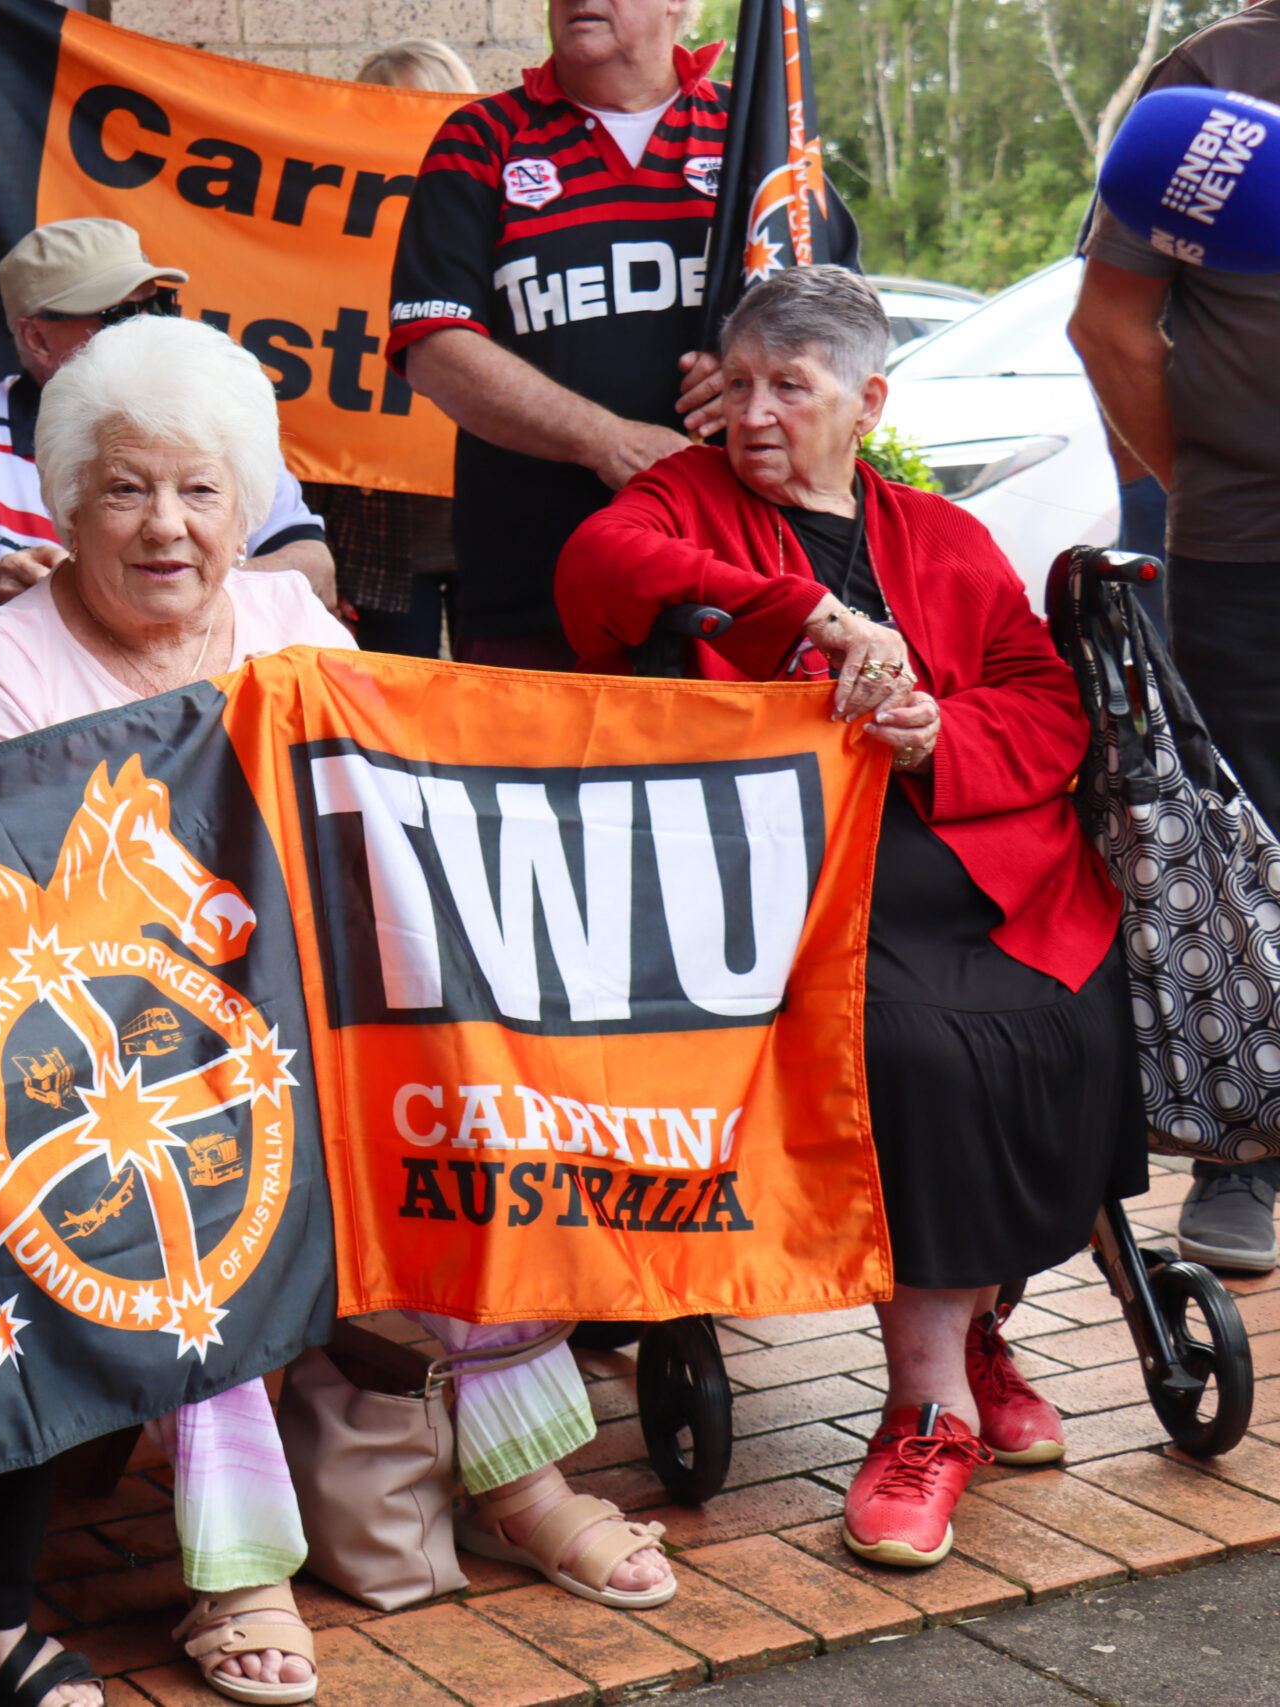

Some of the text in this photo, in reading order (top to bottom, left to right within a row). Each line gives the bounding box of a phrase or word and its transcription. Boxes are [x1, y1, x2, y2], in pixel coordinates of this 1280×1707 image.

[1176, 108, 1238, 183] NBN
[1186, 120, 1266, 225] NEWS
[391, 300, 472, 320] MEMBER
[310, 754, 809, 1022] TWU
[219, 1121, 283, 1280] OF AUSTRALIA
[398, 1157, 755, 1233] AUSTRALIA
[15, 1228, 128, 1324] UNION
